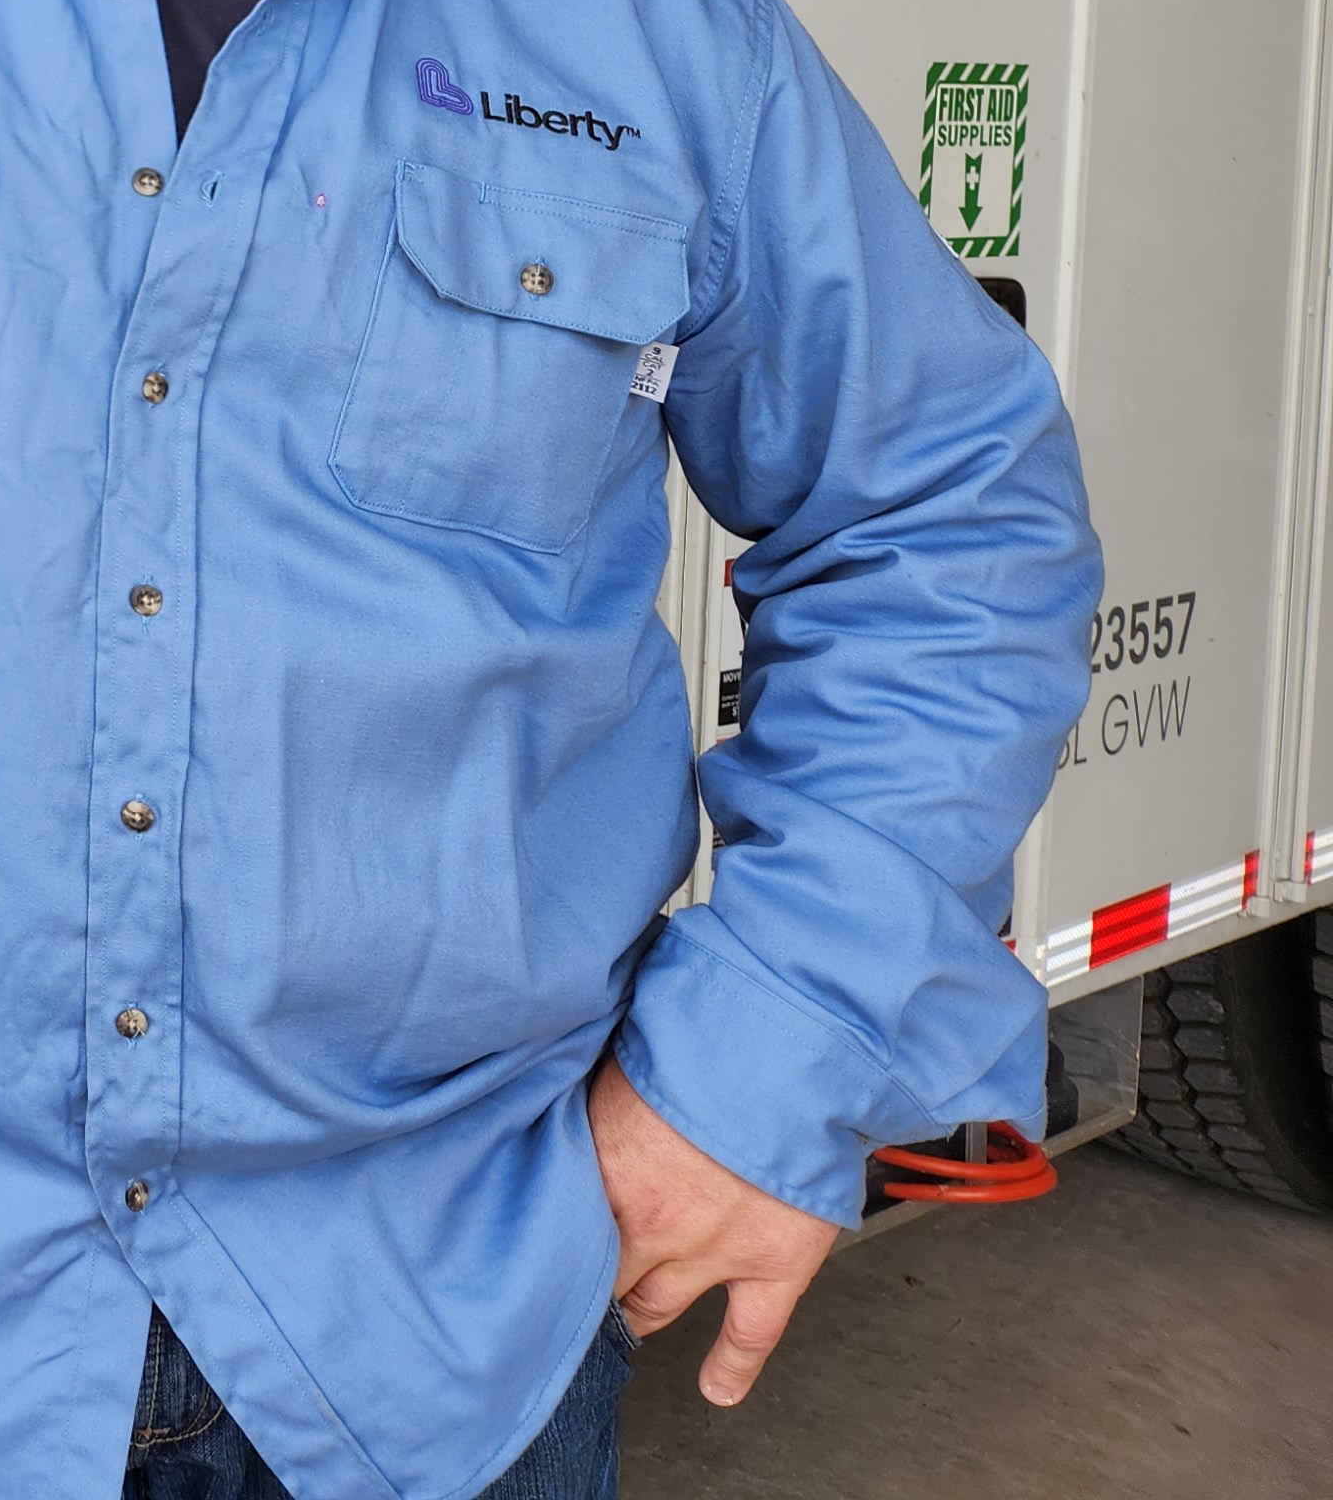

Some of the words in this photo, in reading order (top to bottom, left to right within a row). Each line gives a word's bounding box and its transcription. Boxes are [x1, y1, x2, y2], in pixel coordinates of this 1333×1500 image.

[480, 91, 623, 151] Liberty
[939, 88, 984, 122] FIRST
[987, 88, 1014, 122] AID
[937, 124, 1012, 147] SUPPLIES
[630, 380, 657, 395] 2112
[1102, 676, 1190, 756] GVW
